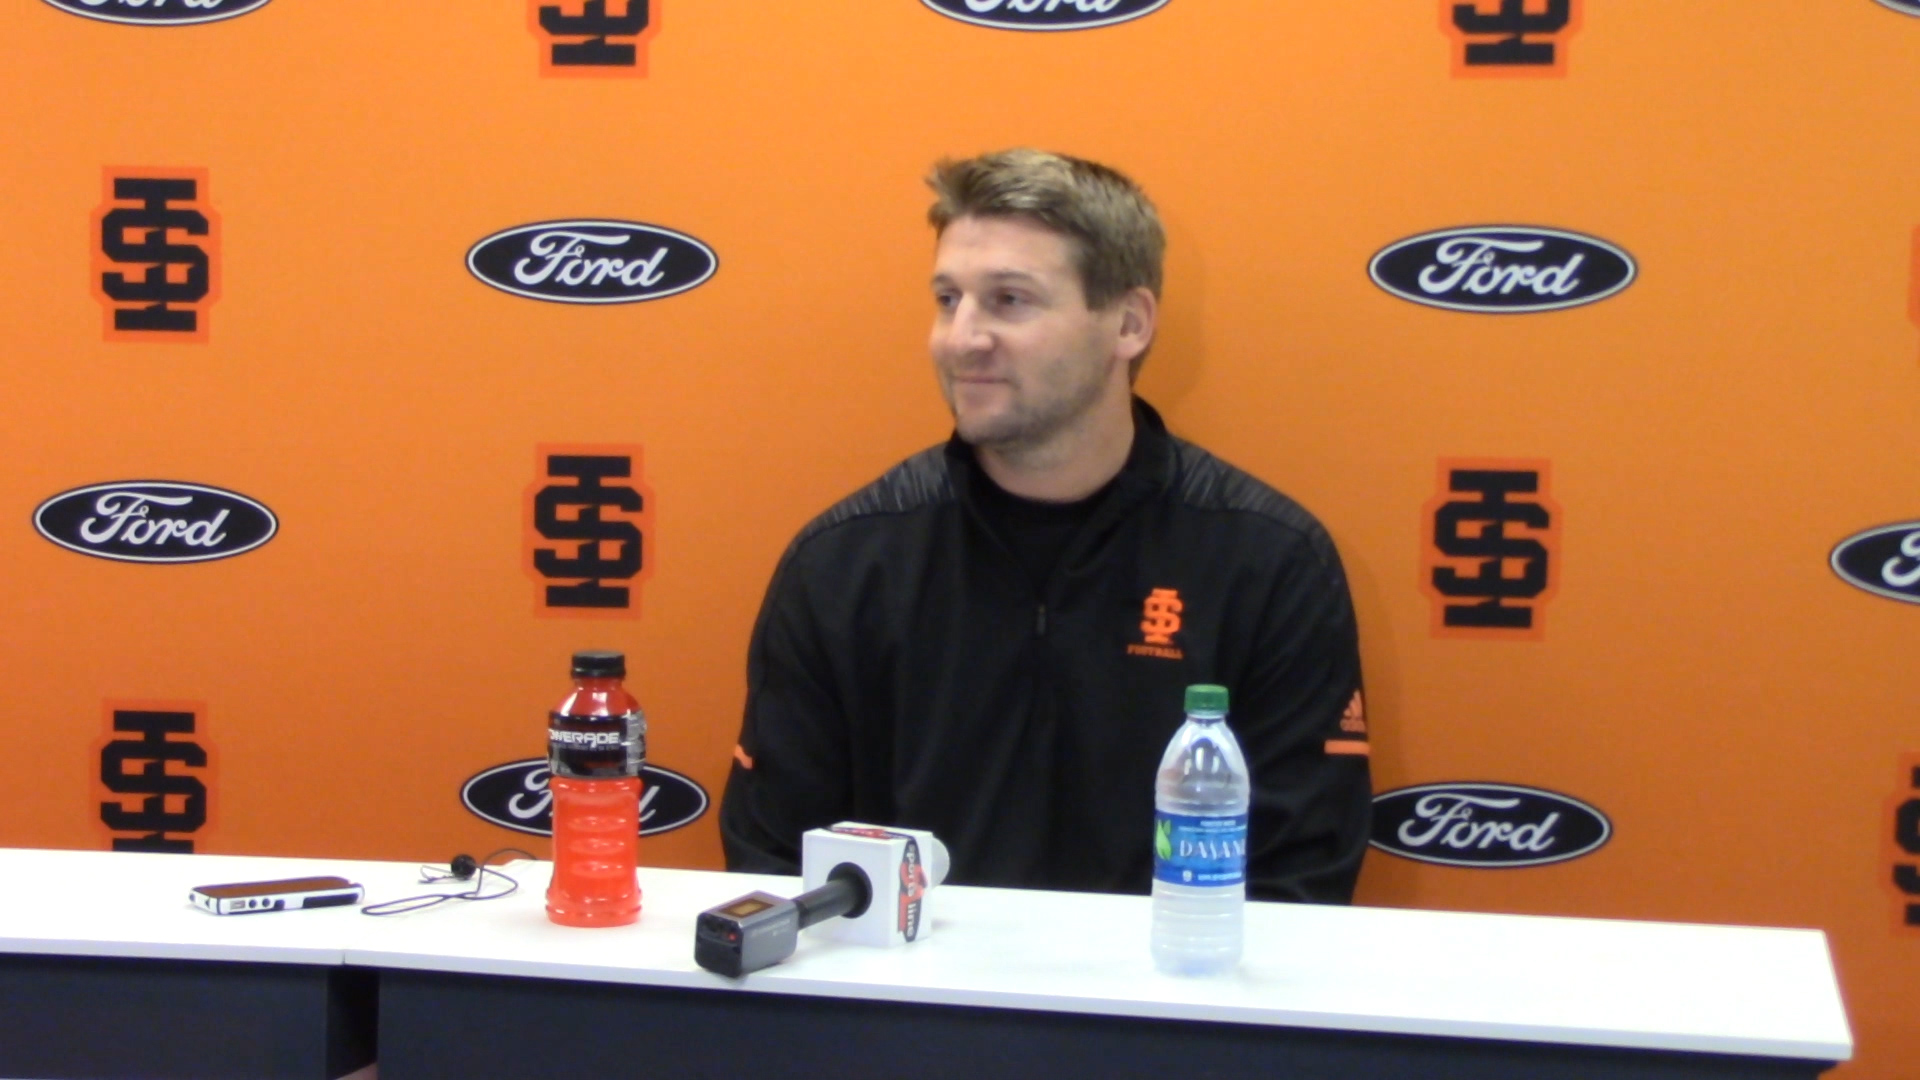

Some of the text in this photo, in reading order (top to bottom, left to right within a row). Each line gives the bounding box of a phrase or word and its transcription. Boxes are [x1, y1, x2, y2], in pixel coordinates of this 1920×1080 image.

[514, 230, 669, 287] Ford
[1418, 236, 1585, 296] Ford
[79, 491, 231, 547] Ford
[1397, 793, 1561, 852] Ford
